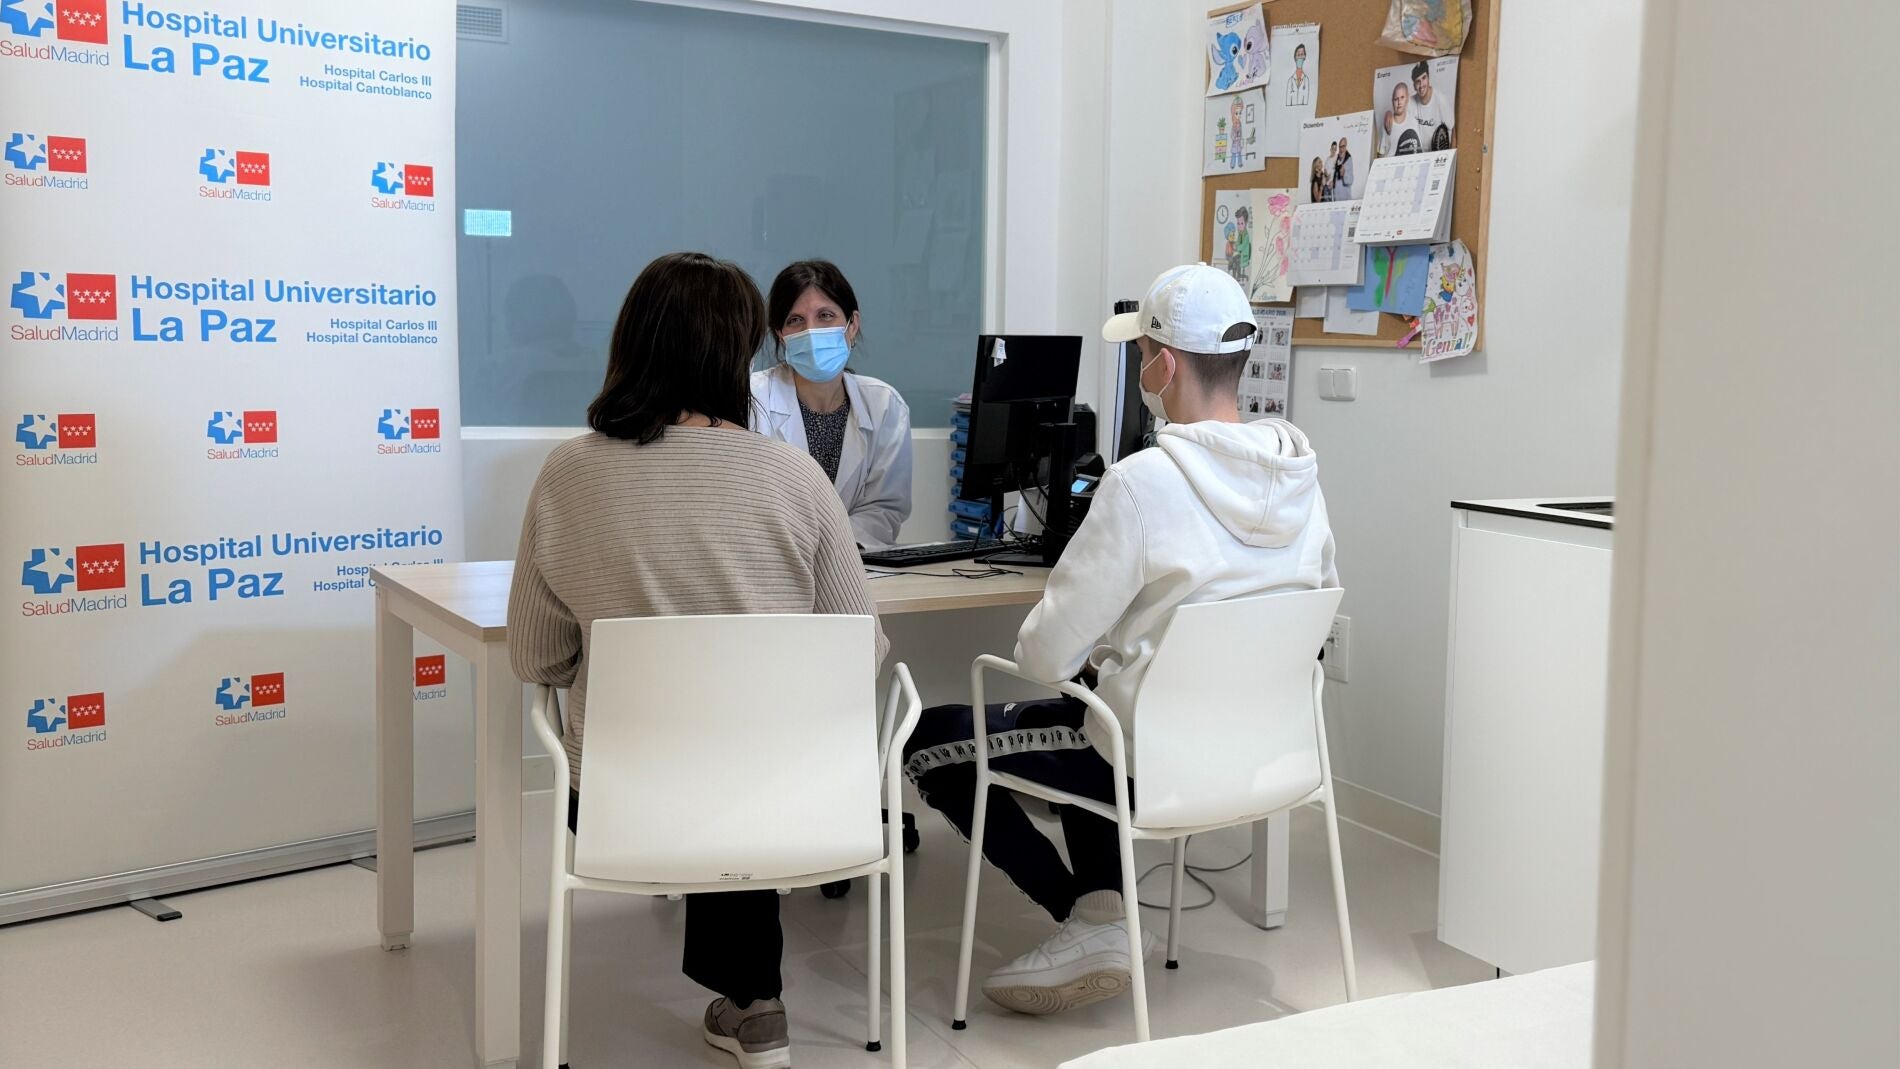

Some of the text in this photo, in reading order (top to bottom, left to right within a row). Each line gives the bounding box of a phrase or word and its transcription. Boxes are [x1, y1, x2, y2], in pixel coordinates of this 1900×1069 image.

[123, 1, 430, 60] Hospital Universitario
[0, 40, 109, 66] SaludMadrid
[124, 34, 270, 83] La Paz
[324, 65, 431, 86] Hospital Carlos III
[300, 76, 431, 99] Hospital Cantoblanco
[5, 173, 88, 190] SaludMadrid
[200, 186, 271, 201] SaludMadrid
[372, 198, 435, 212] SaludMadrid
[131, 275, 436, 306] Hospital Universitario
[11, 325, 118, 342] SaludMadrid
[133, 308, 277, 342] La Paz
[330, 319, 437, 332] Hospital Carlos III
[306, 332, 438, 345] Hospital Cantoblanco
[207, 447, 279, 460] SaludMadrid
[377, 443, 441, 455] SaludMadrid
[16, 453, 97, 466] SaludMadrid
[139, 525, 443, 566] Hospital Universitario
[141, 567, 285, 606] La Paz
[313, 578, 364, 592] Hospital
[22, 594, 127, 617] SaludMadrid
[413, 688, 447, 701] Madrid
[215, 708, 286, 726] SaludMadrid
[27, 730, 107, 751] SaludMadrid
